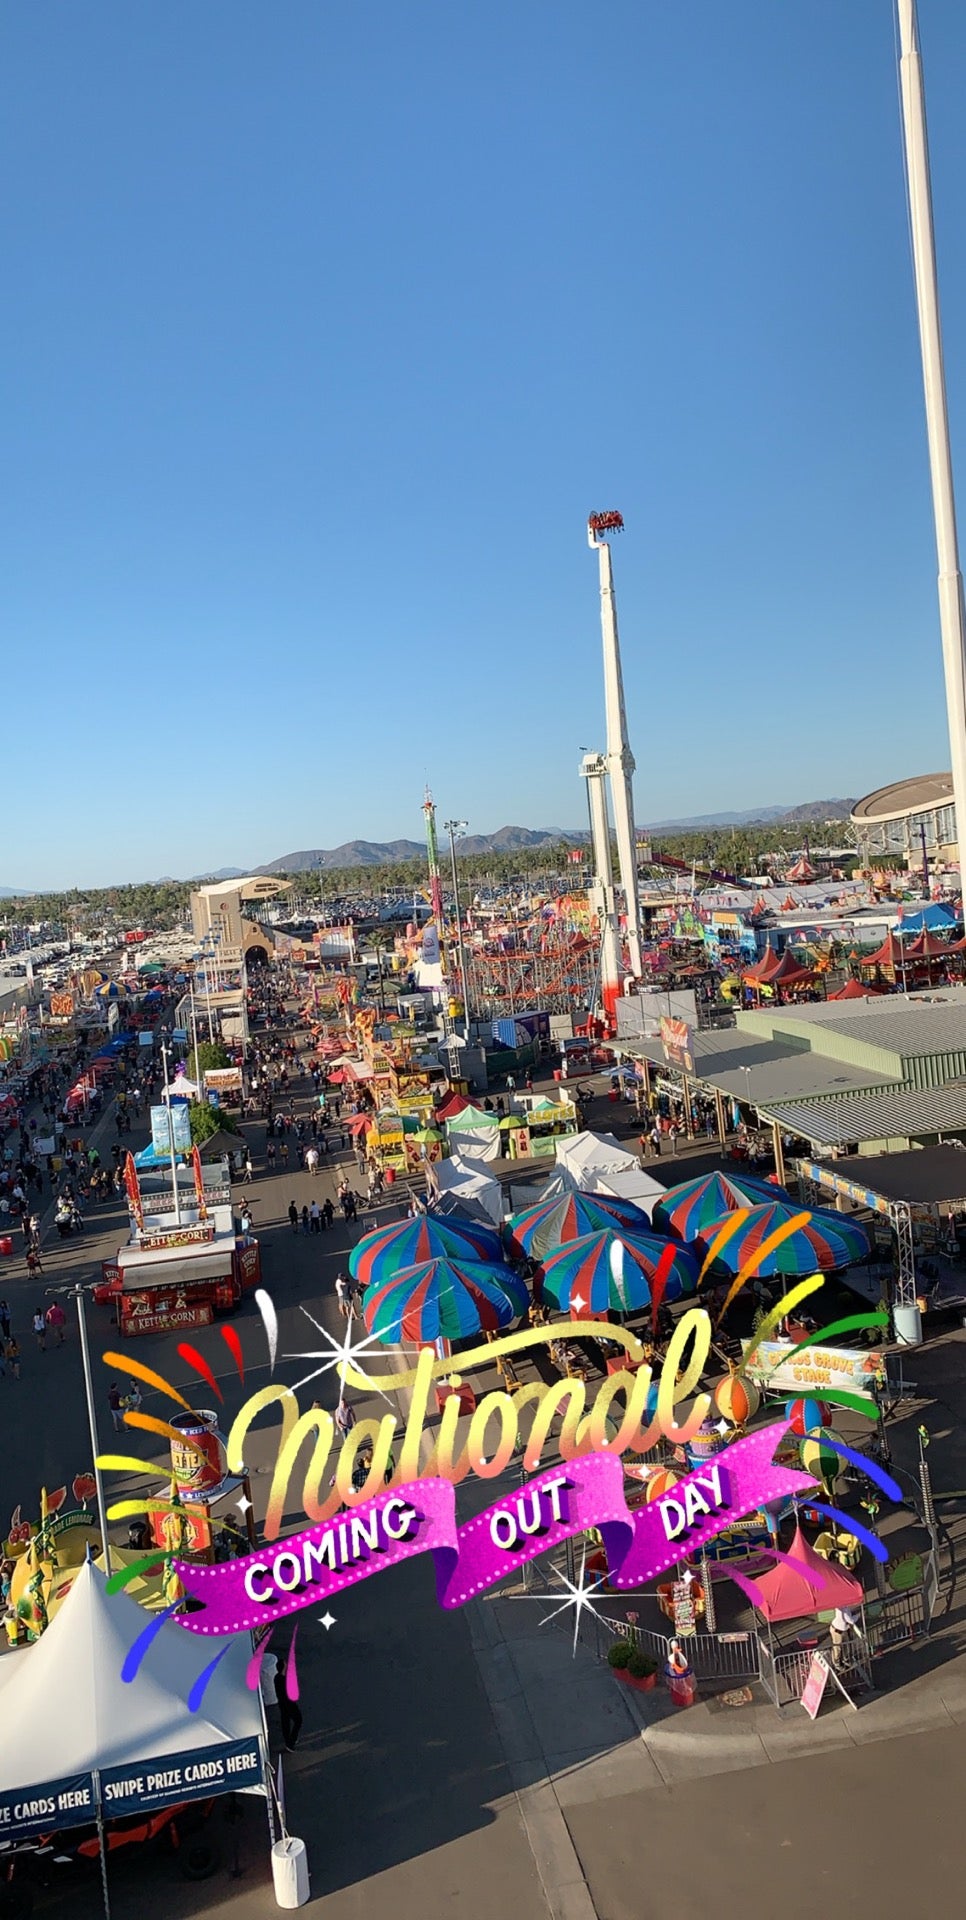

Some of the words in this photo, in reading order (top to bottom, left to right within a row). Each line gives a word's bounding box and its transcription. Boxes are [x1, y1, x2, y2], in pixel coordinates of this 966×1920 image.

[170, 1310, 196, 1323] CORN
[793, 1367, 832, 1385] STAGE
[814, 1352, 855, 1376] GROVE
[104, 1777, 144, 1801] SWIPE
[147, 1769, 182, 1792] PRIZE
[184, 1760, 224, 1783] CARDS
[226, 1752, 258, 1772] HERE
[14, 1796, 56, 1820] CARDS
[58, 1789, 91, 1811] HERE
